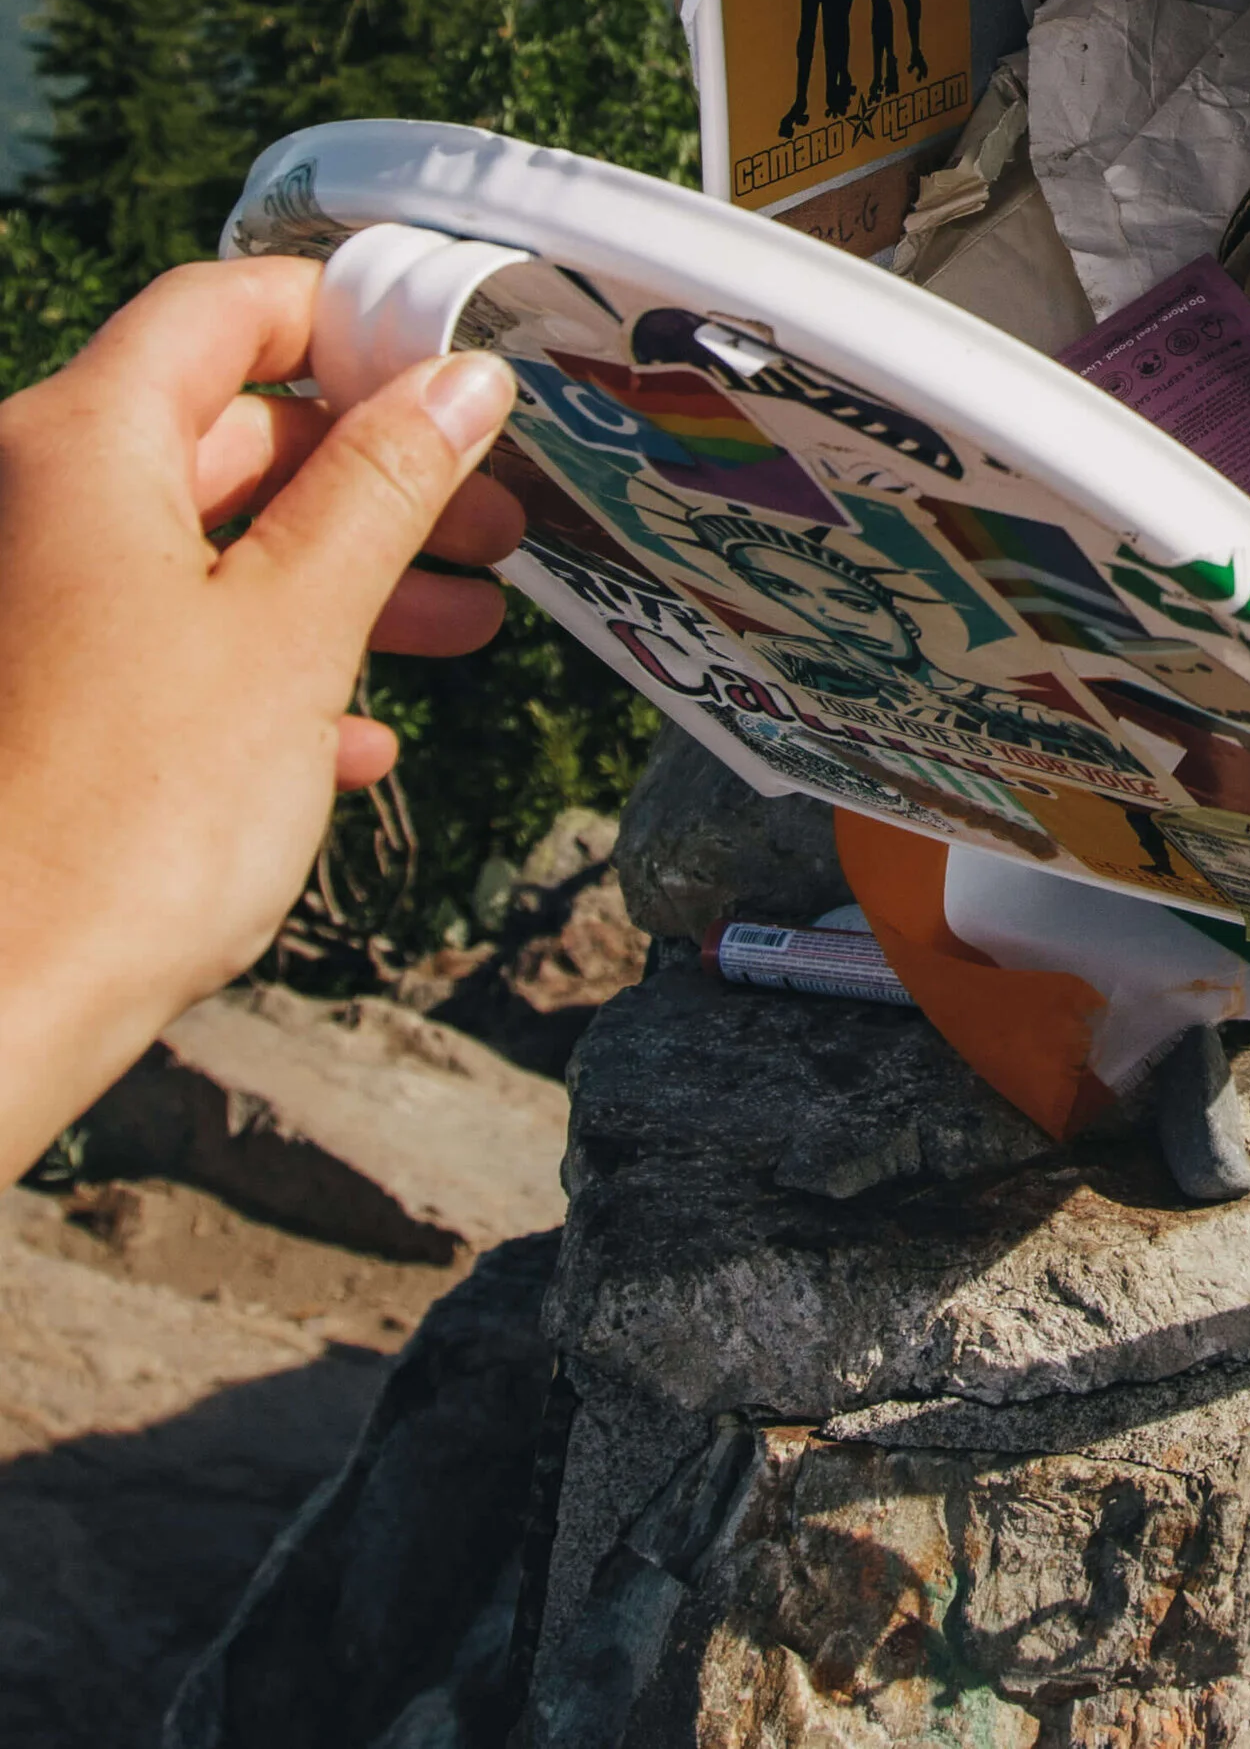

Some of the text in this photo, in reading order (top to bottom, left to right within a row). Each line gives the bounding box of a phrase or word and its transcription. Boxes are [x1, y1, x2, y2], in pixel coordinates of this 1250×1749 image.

[1189, 293, 1207, 308] Do
[1152, 371, 1186, 396] SEPTIC
[812, 693, 1172, 804] YOUR VOTE IS YOUR VOICE
